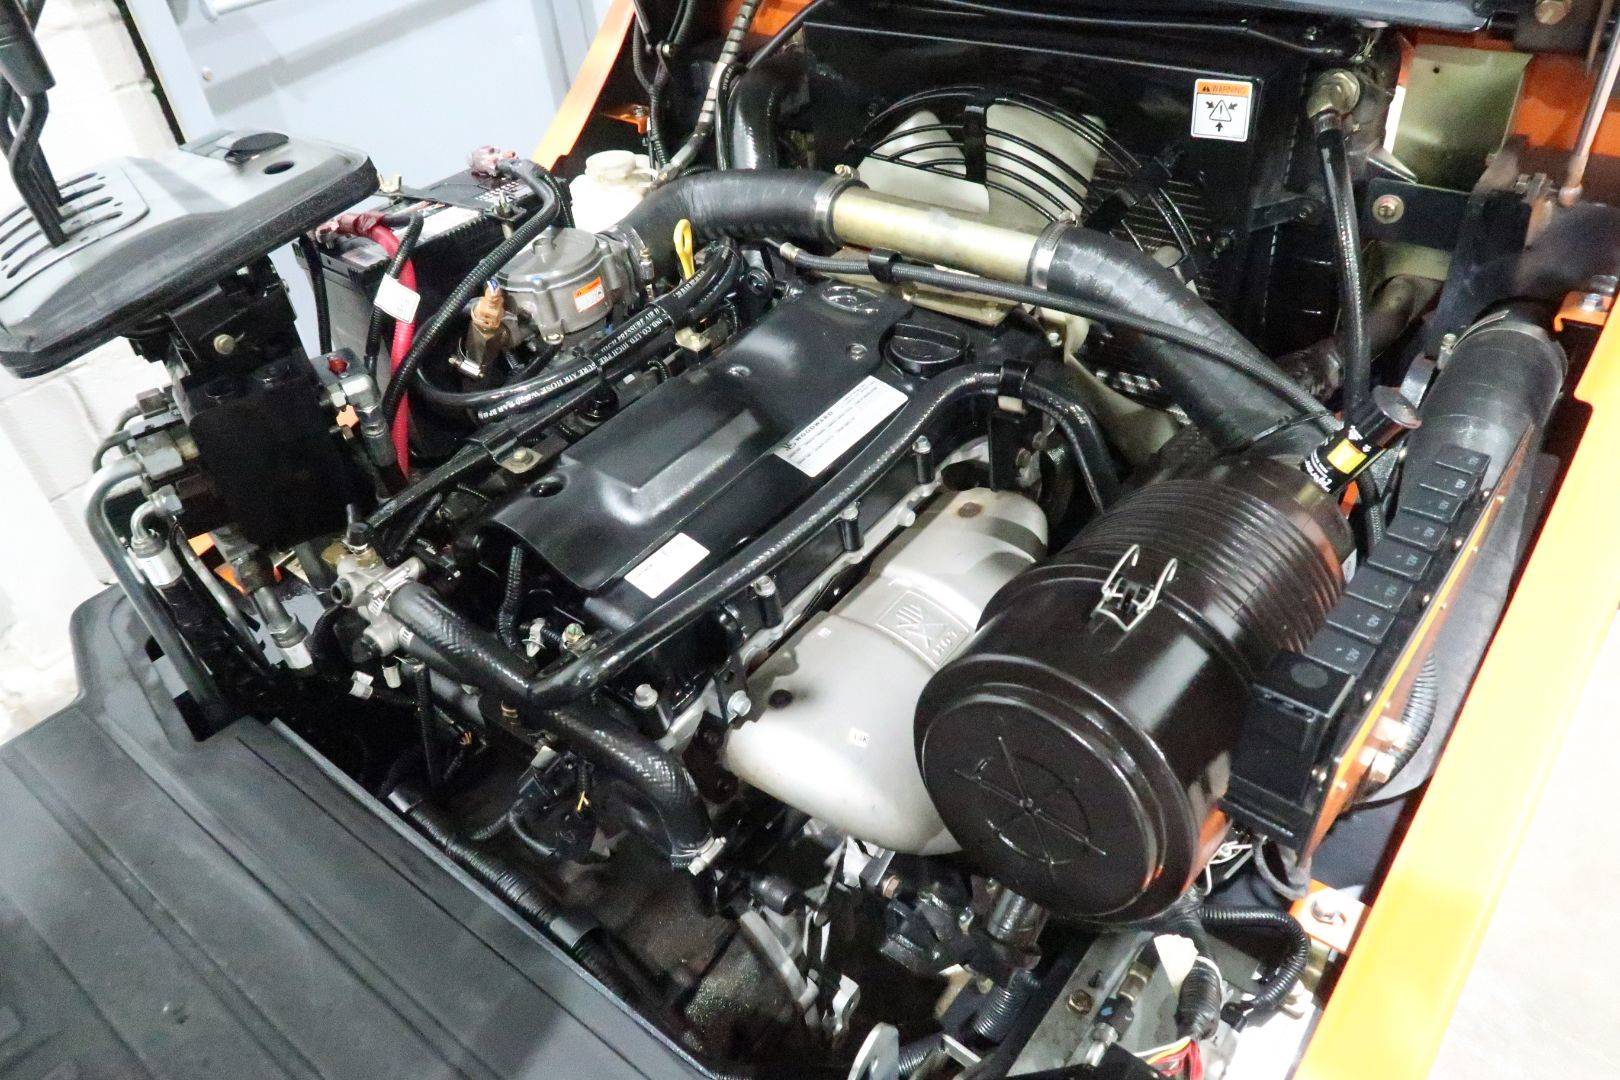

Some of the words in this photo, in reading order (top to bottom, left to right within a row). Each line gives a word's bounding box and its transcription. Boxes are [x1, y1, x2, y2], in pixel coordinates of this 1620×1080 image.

[616, 318, 646, 341] PRESSURE
[540, 379, 564, 394] HOSE
[562, 373, 577, 383] AIR
[795, 411, 833, 442] WOODWARD
